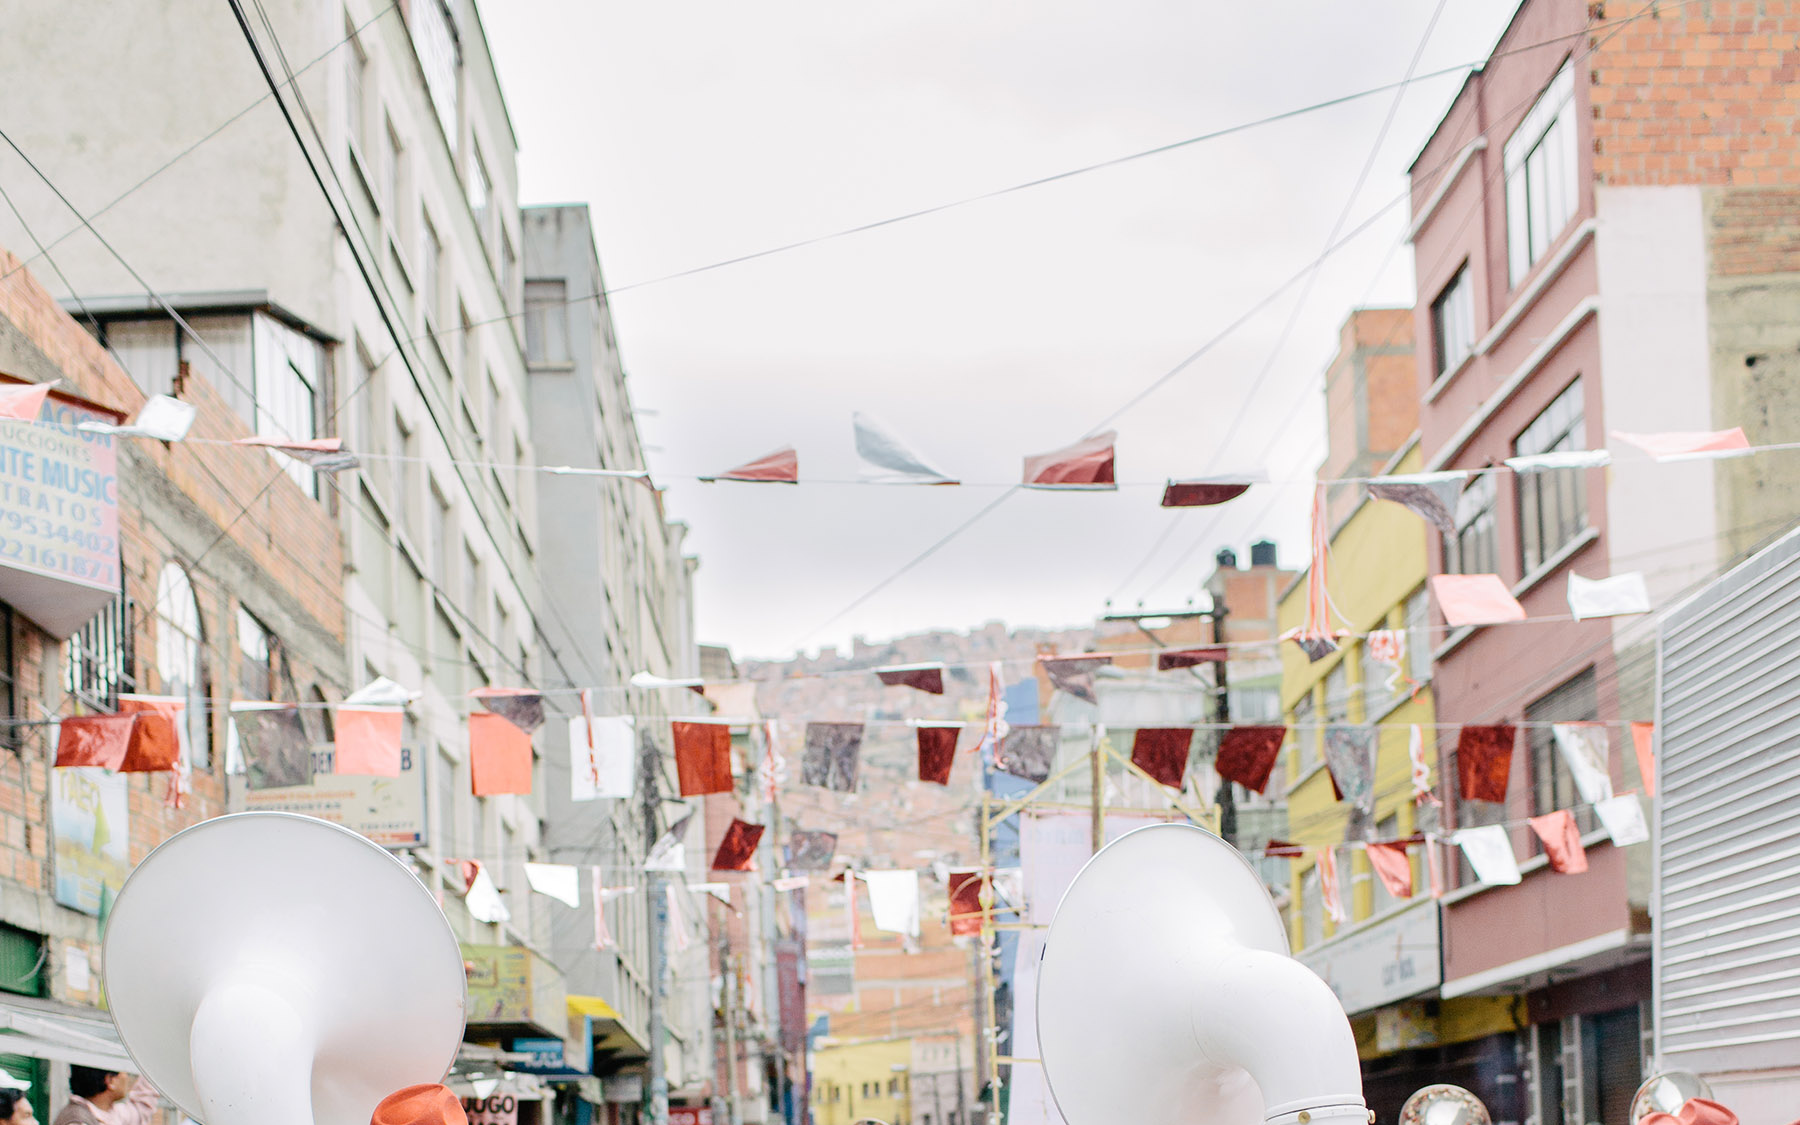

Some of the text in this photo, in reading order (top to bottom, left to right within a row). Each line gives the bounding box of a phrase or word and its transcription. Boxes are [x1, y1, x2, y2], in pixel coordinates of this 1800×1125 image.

[33, 400, 112, 449] ACION
[0, 445, 116, 505] TE MUSIC
